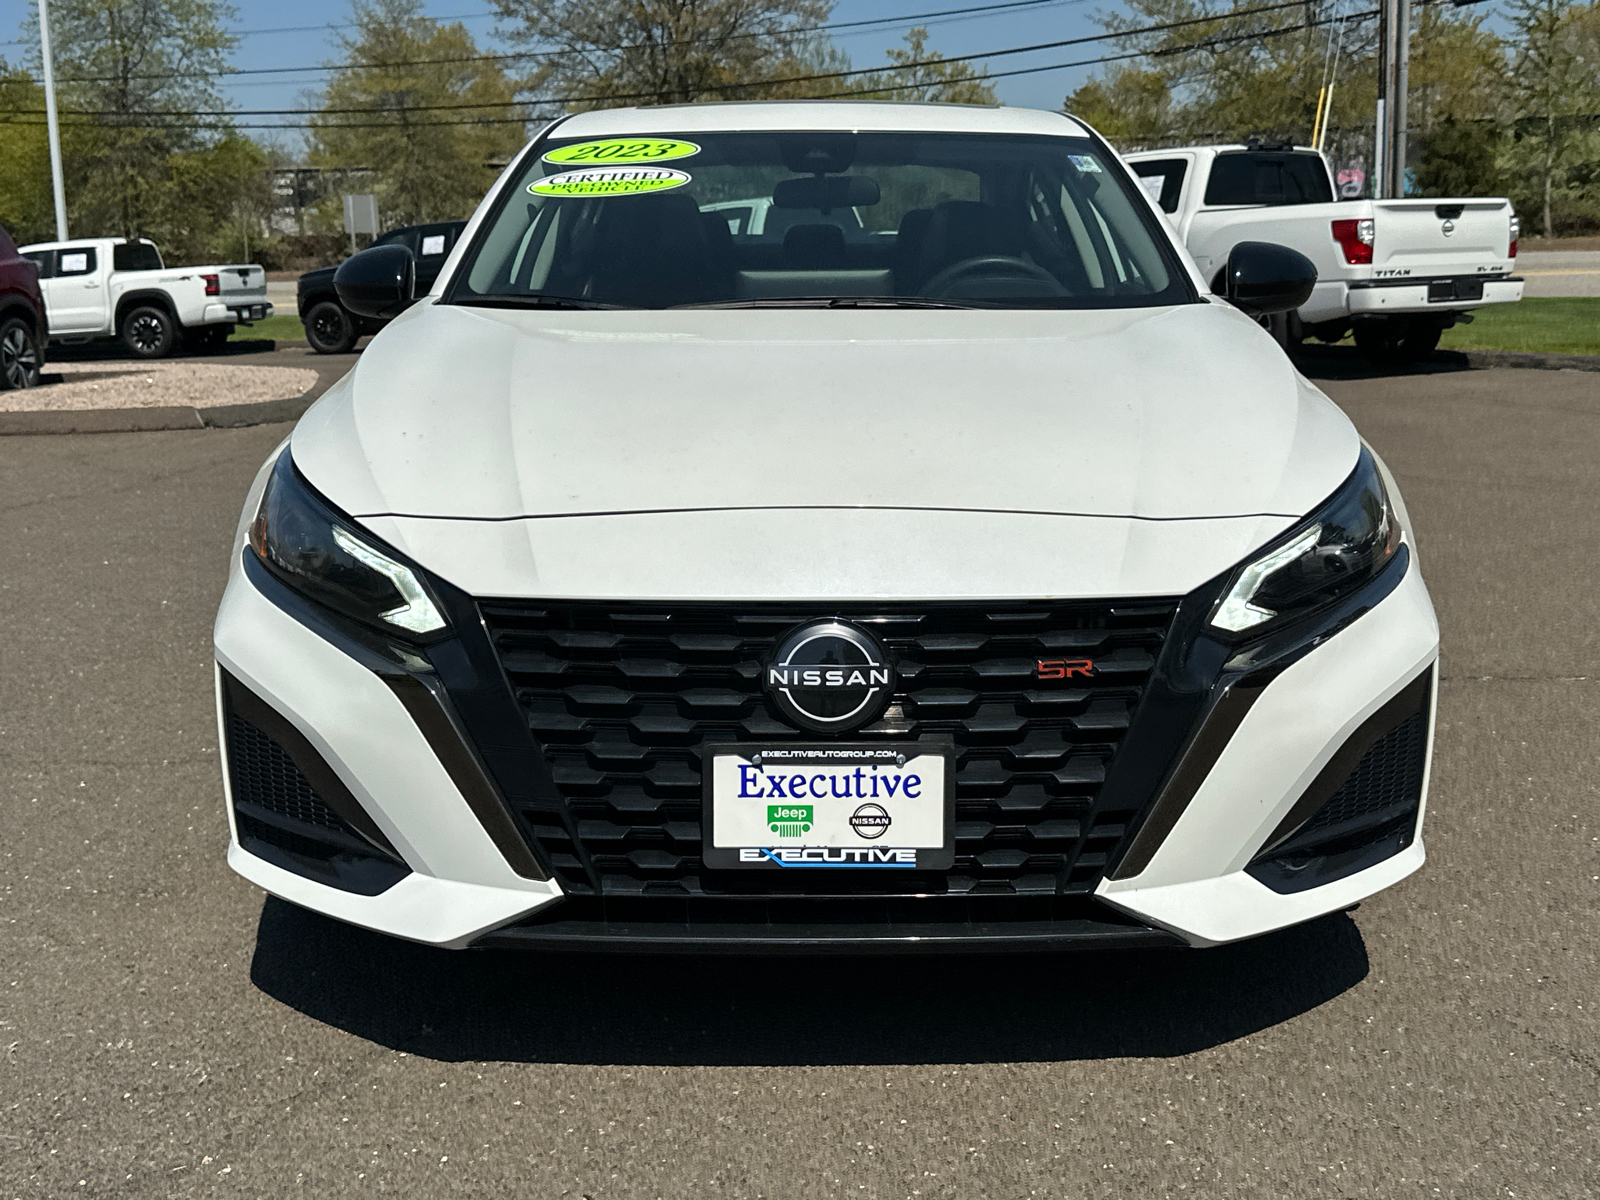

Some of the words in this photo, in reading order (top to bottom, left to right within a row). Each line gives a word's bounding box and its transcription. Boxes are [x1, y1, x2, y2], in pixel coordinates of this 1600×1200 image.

[565, 143, 678, 161] 2023
[549, 171, 674, 185] CERTIFIED
[550, 180, 665, 190] PRE-OWNED
[567, 185, 646, 194] VEHICLE
[1037, 659, 1095, 680] SR
[770, 668, 889, 687] NISSAN
[761, 750, 897, 758] EXECUTIVEAUTOGROUP.COM
[737, 763, 922, 799] Executive
[773, 806, 807, 820] Jeep
[851, 817, 889, 825] NISSAN
[739, 848, 917, 863] EXECUTIVE
